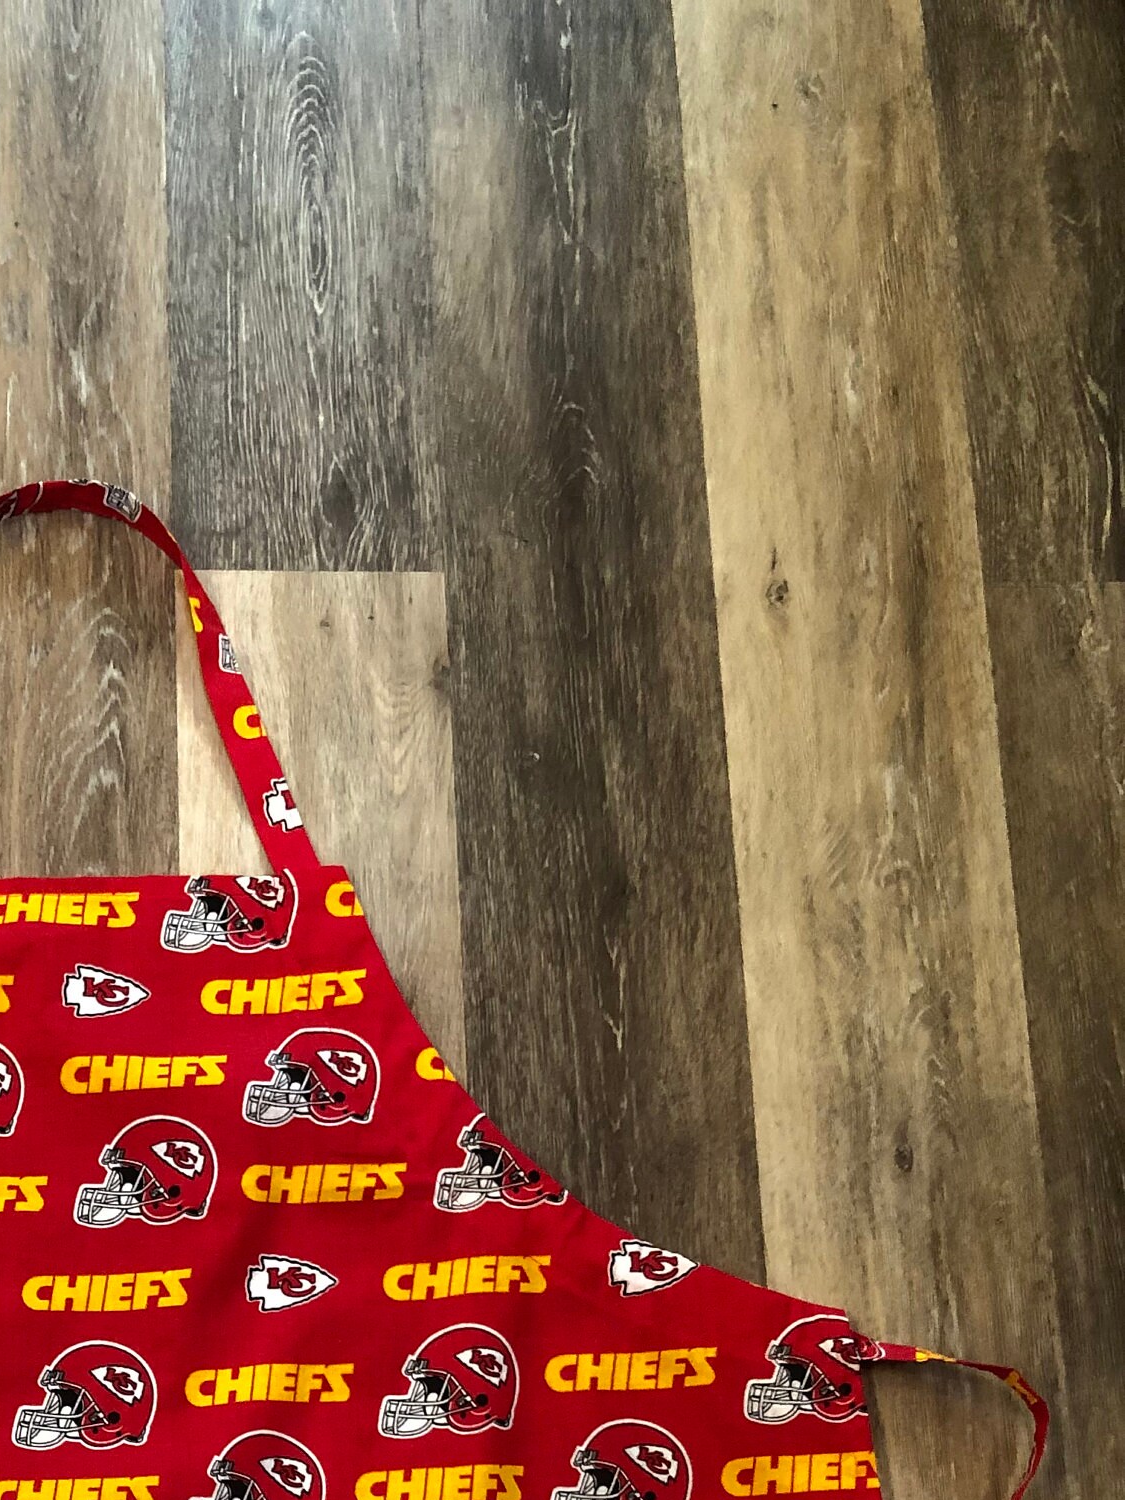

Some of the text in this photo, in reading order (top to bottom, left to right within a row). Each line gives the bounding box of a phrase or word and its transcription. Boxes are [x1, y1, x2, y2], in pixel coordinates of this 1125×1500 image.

[83, 977, 129, 1007] KC
[200, 968, 367, 1015] CHIEFS
[60, 1054, 228, 1095] CHIEFS
[240, 1162, 407, 1204] CHIEFS
[267, 1267, 316, 1297] KC
[382, 1255, 551, 1301] CHIEFS
[629, 1251, 678, 1281] KC
[21, 1268, 192, 1312] CHIEFS
[184, 1363, 354, 1407] CHIEFS
[544, 1347, 717, 1392] CHIEFS
